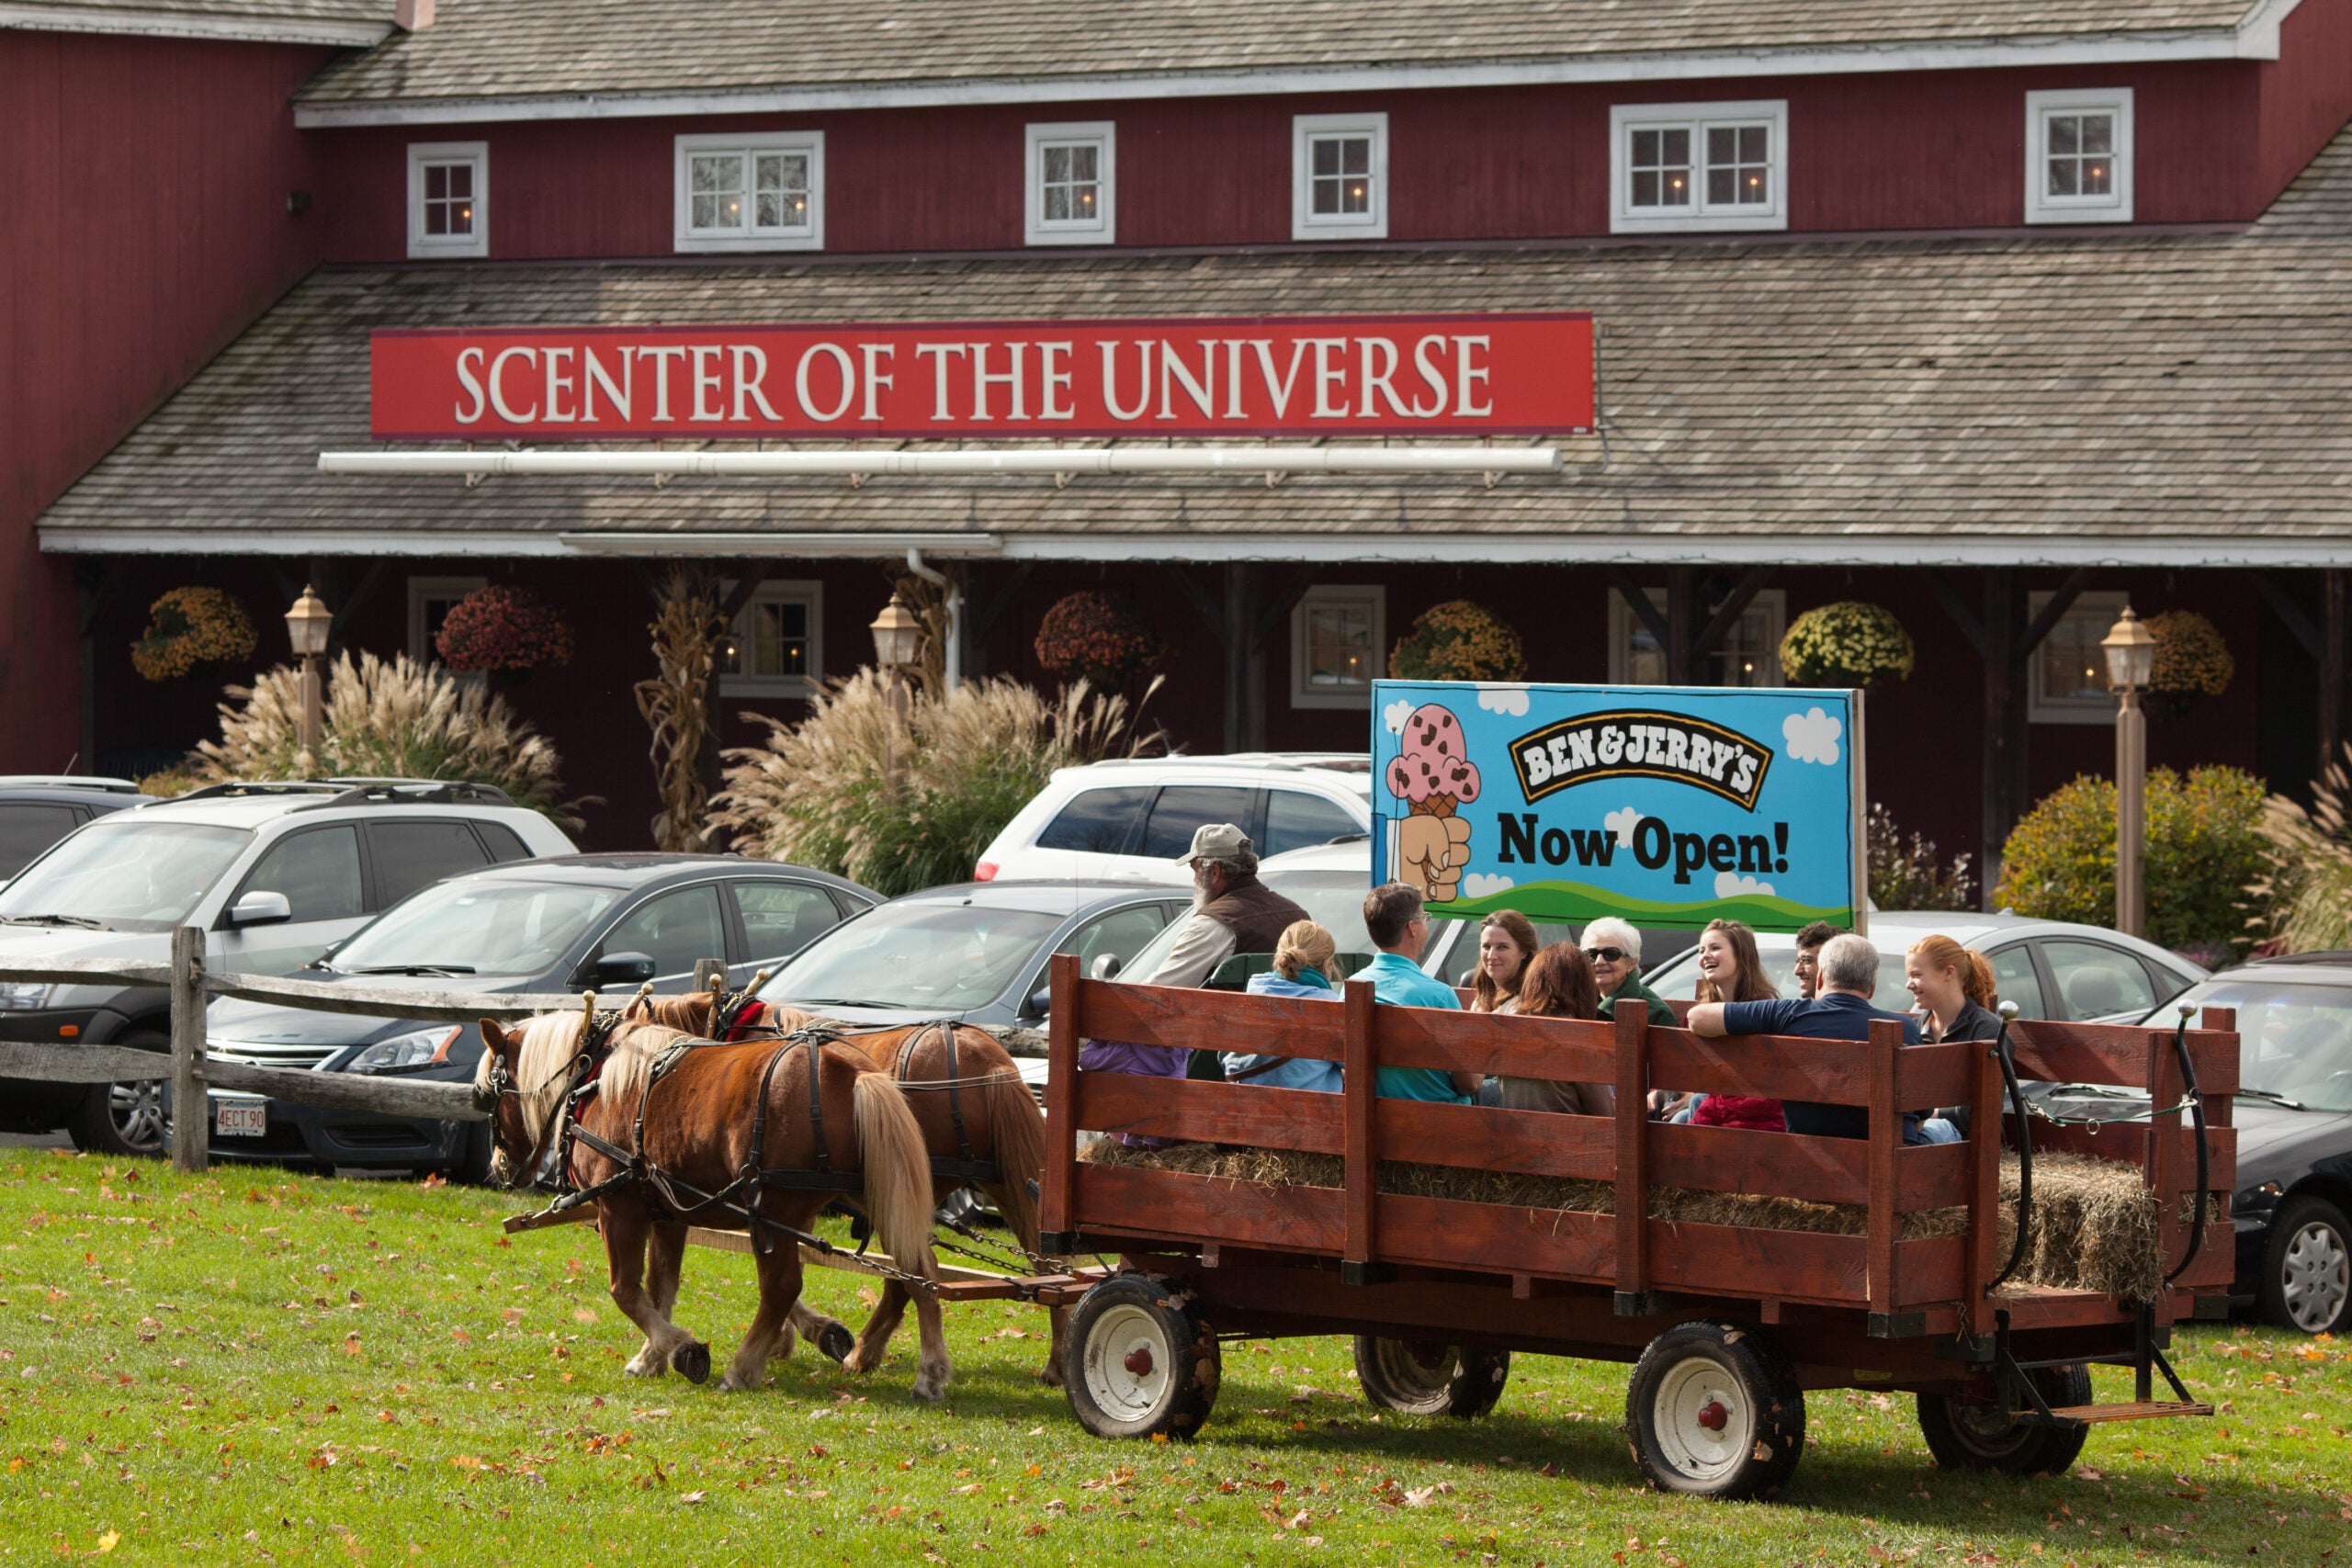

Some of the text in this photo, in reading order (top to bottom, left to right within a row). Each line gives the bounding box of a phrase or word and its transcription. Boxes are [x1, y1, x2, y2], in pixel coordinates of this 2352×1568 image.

[455, 334, 1492, 424] SCENTER OF THE UNIVERSE
[1498, 813, 1789, 885] Now Open!
